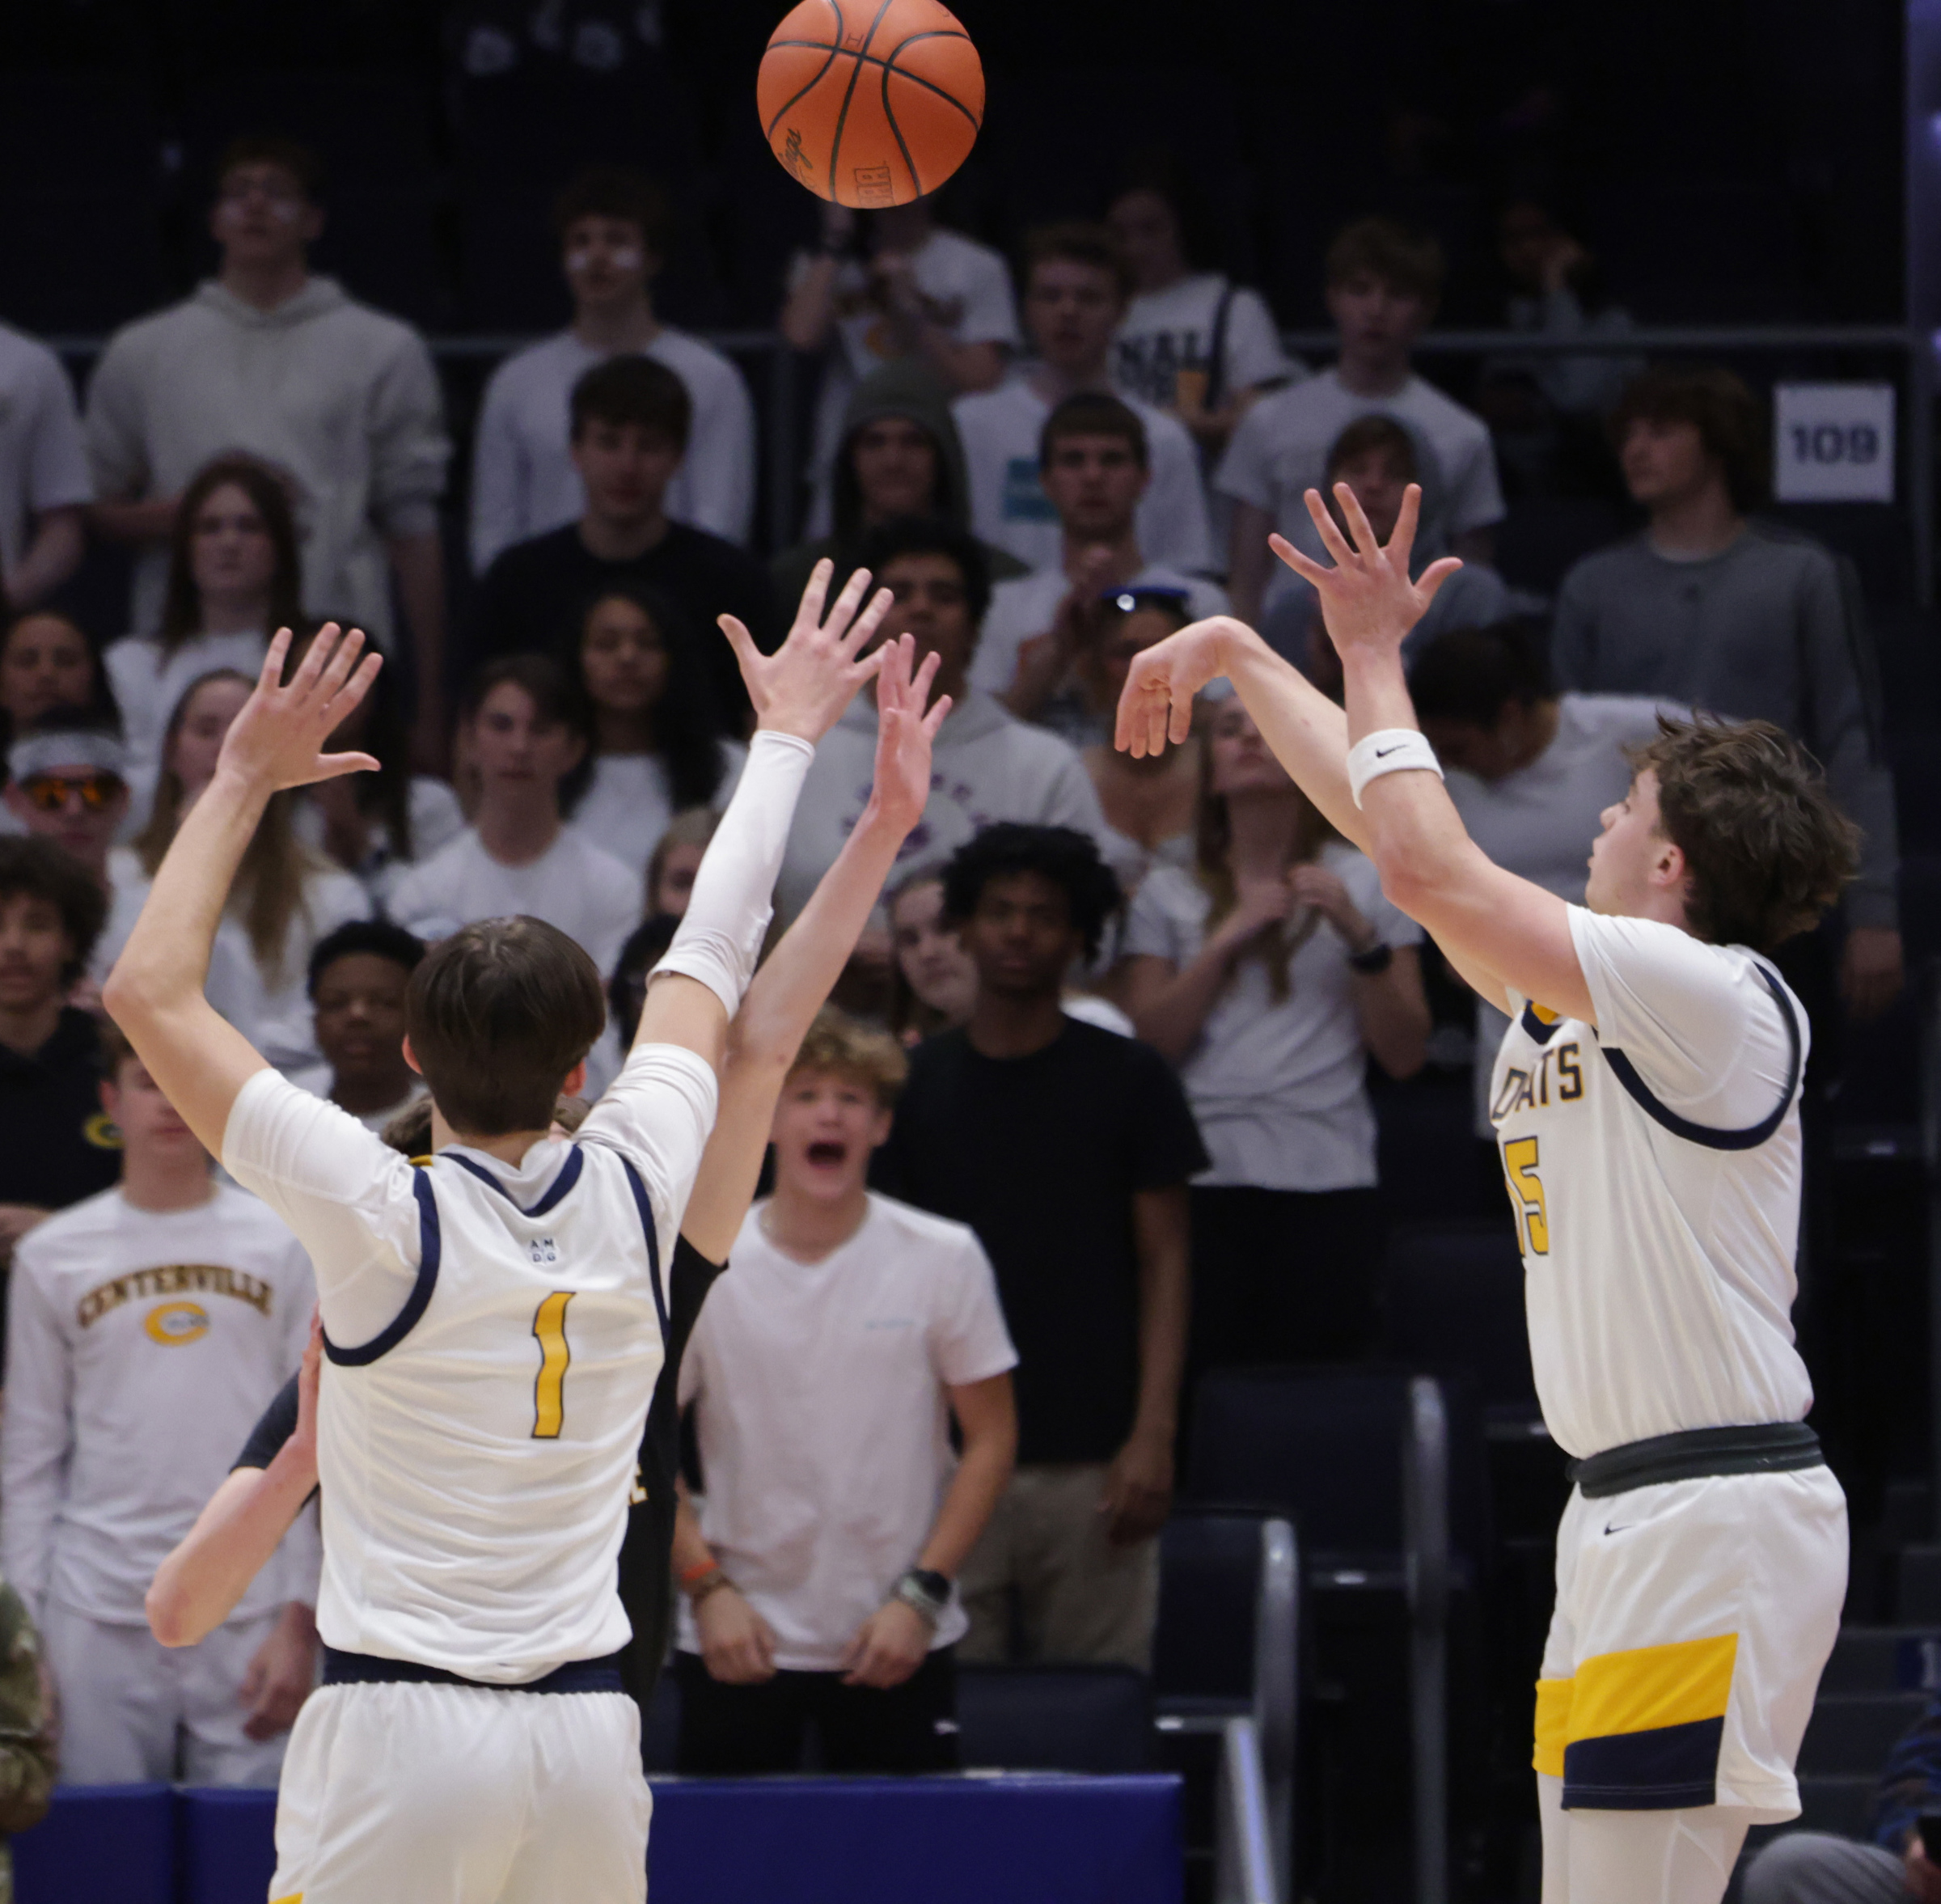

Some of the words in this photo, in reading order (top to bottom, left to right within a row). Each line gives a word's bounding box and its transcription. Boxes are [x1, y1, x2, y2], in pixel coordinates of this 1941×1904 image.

[1793, 424, 1880, 464] 109
[76, 1265, 273, 1328] CENTERVILLE
[531, 1291, 576, 1439] 1
